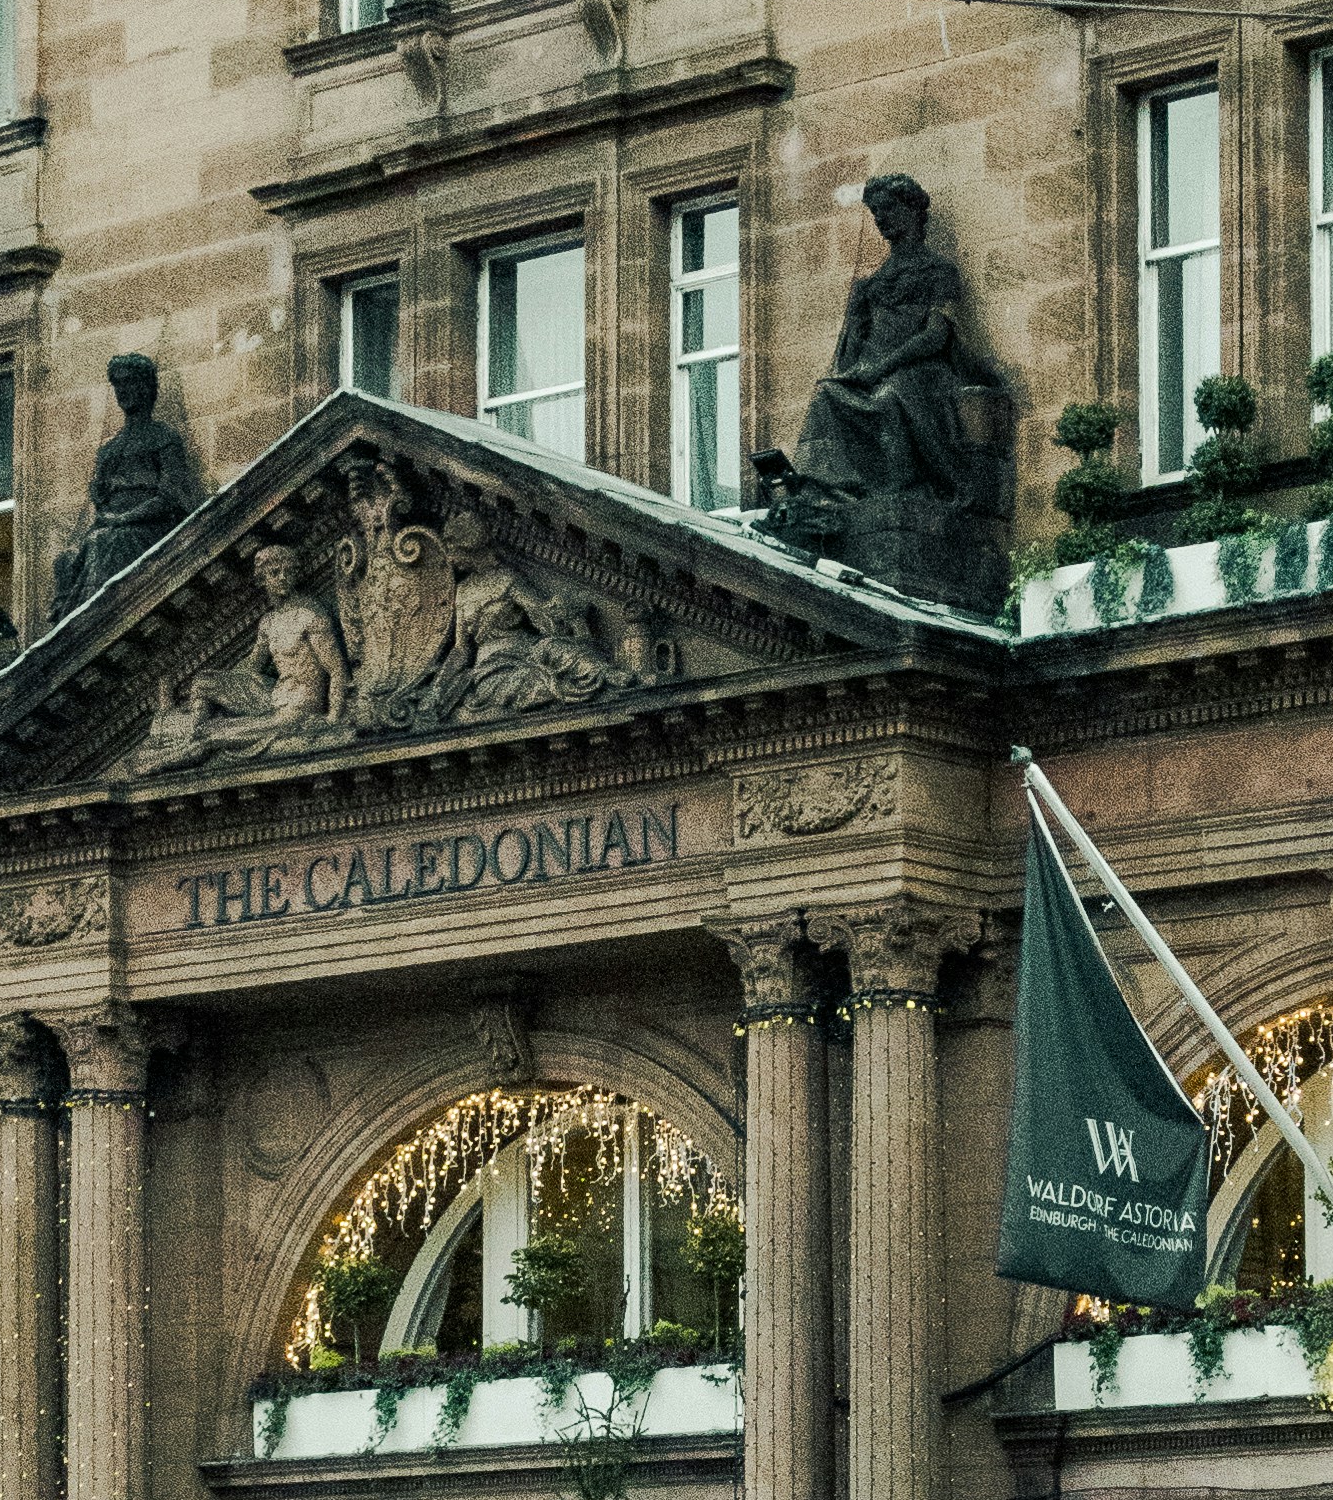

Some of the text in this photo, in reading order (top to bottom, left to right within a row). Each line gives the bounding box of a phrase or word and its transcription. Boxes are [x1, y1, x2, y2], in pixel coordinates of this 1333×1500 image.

[176, 802, 682, 931] THE CALEDONIAN
[1027, 1174, 1197, 1233] WALDORF ASTORIA
[1029, 1205, 1194, 1252] EDINBURGH THE CALEDONIAN
